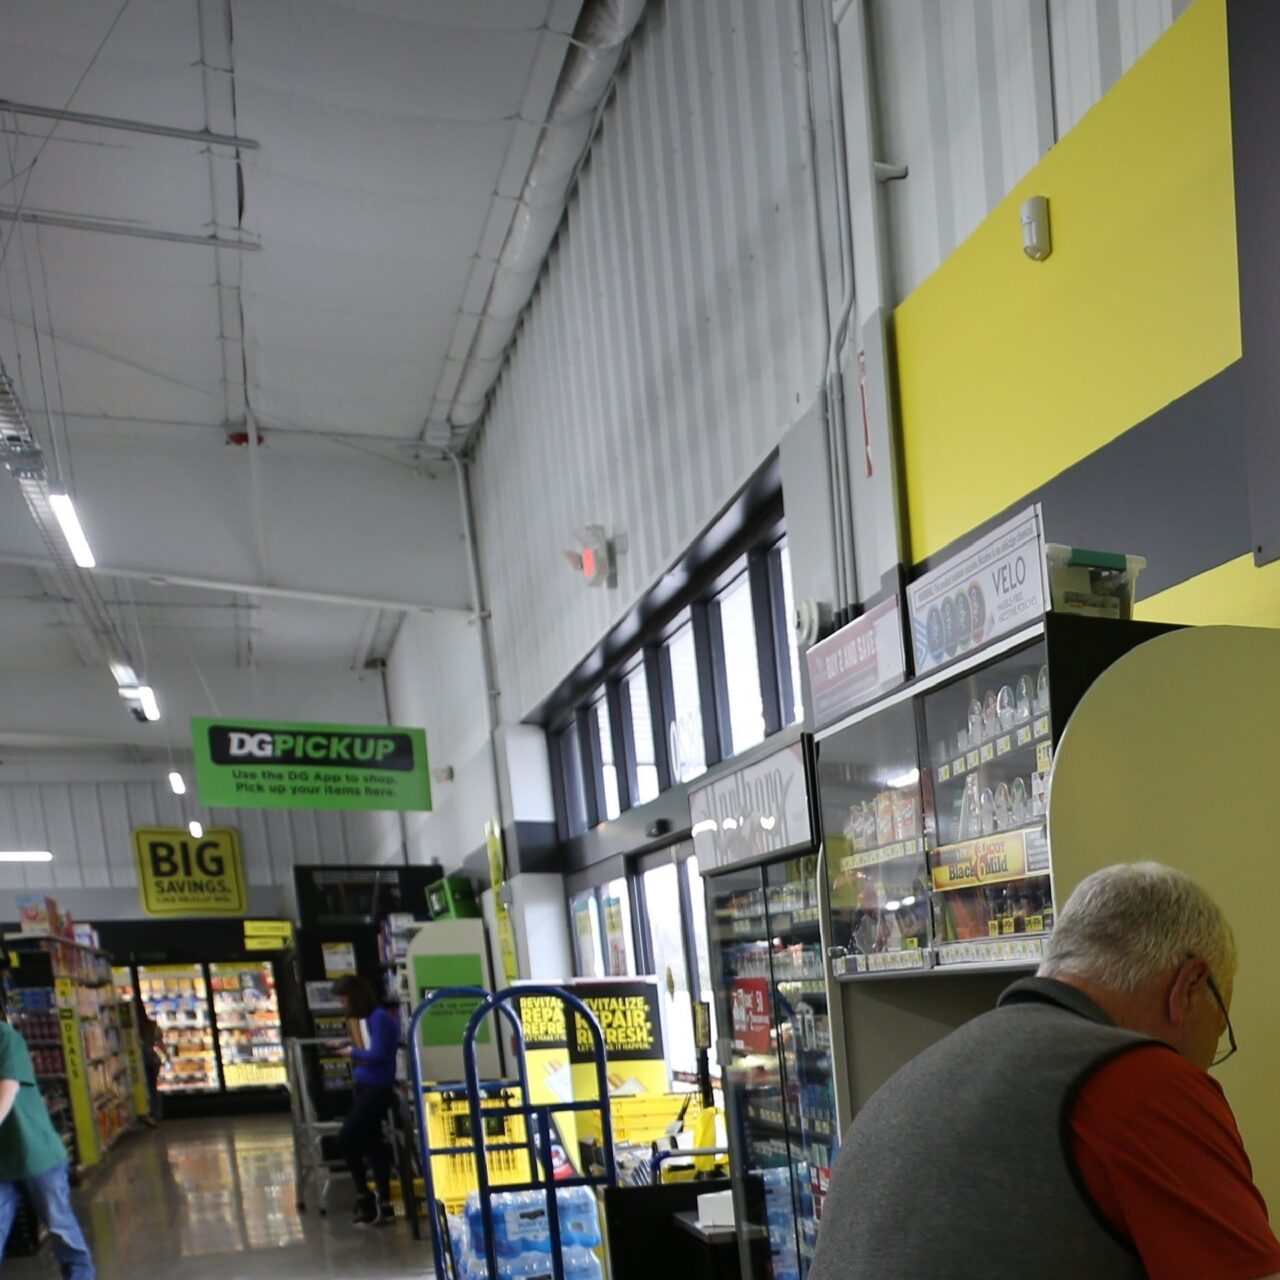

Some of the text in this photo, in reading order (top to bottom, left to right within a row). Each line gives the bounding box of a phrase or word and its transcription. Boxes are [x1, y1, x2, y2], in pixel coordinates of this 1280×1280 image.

[992, 555, 1026, 596] VELO
[149, 841, 225, 878] BIG
[948, 863, 976, 881] Black
[155, 880, 231, 894] SAVINGS.
